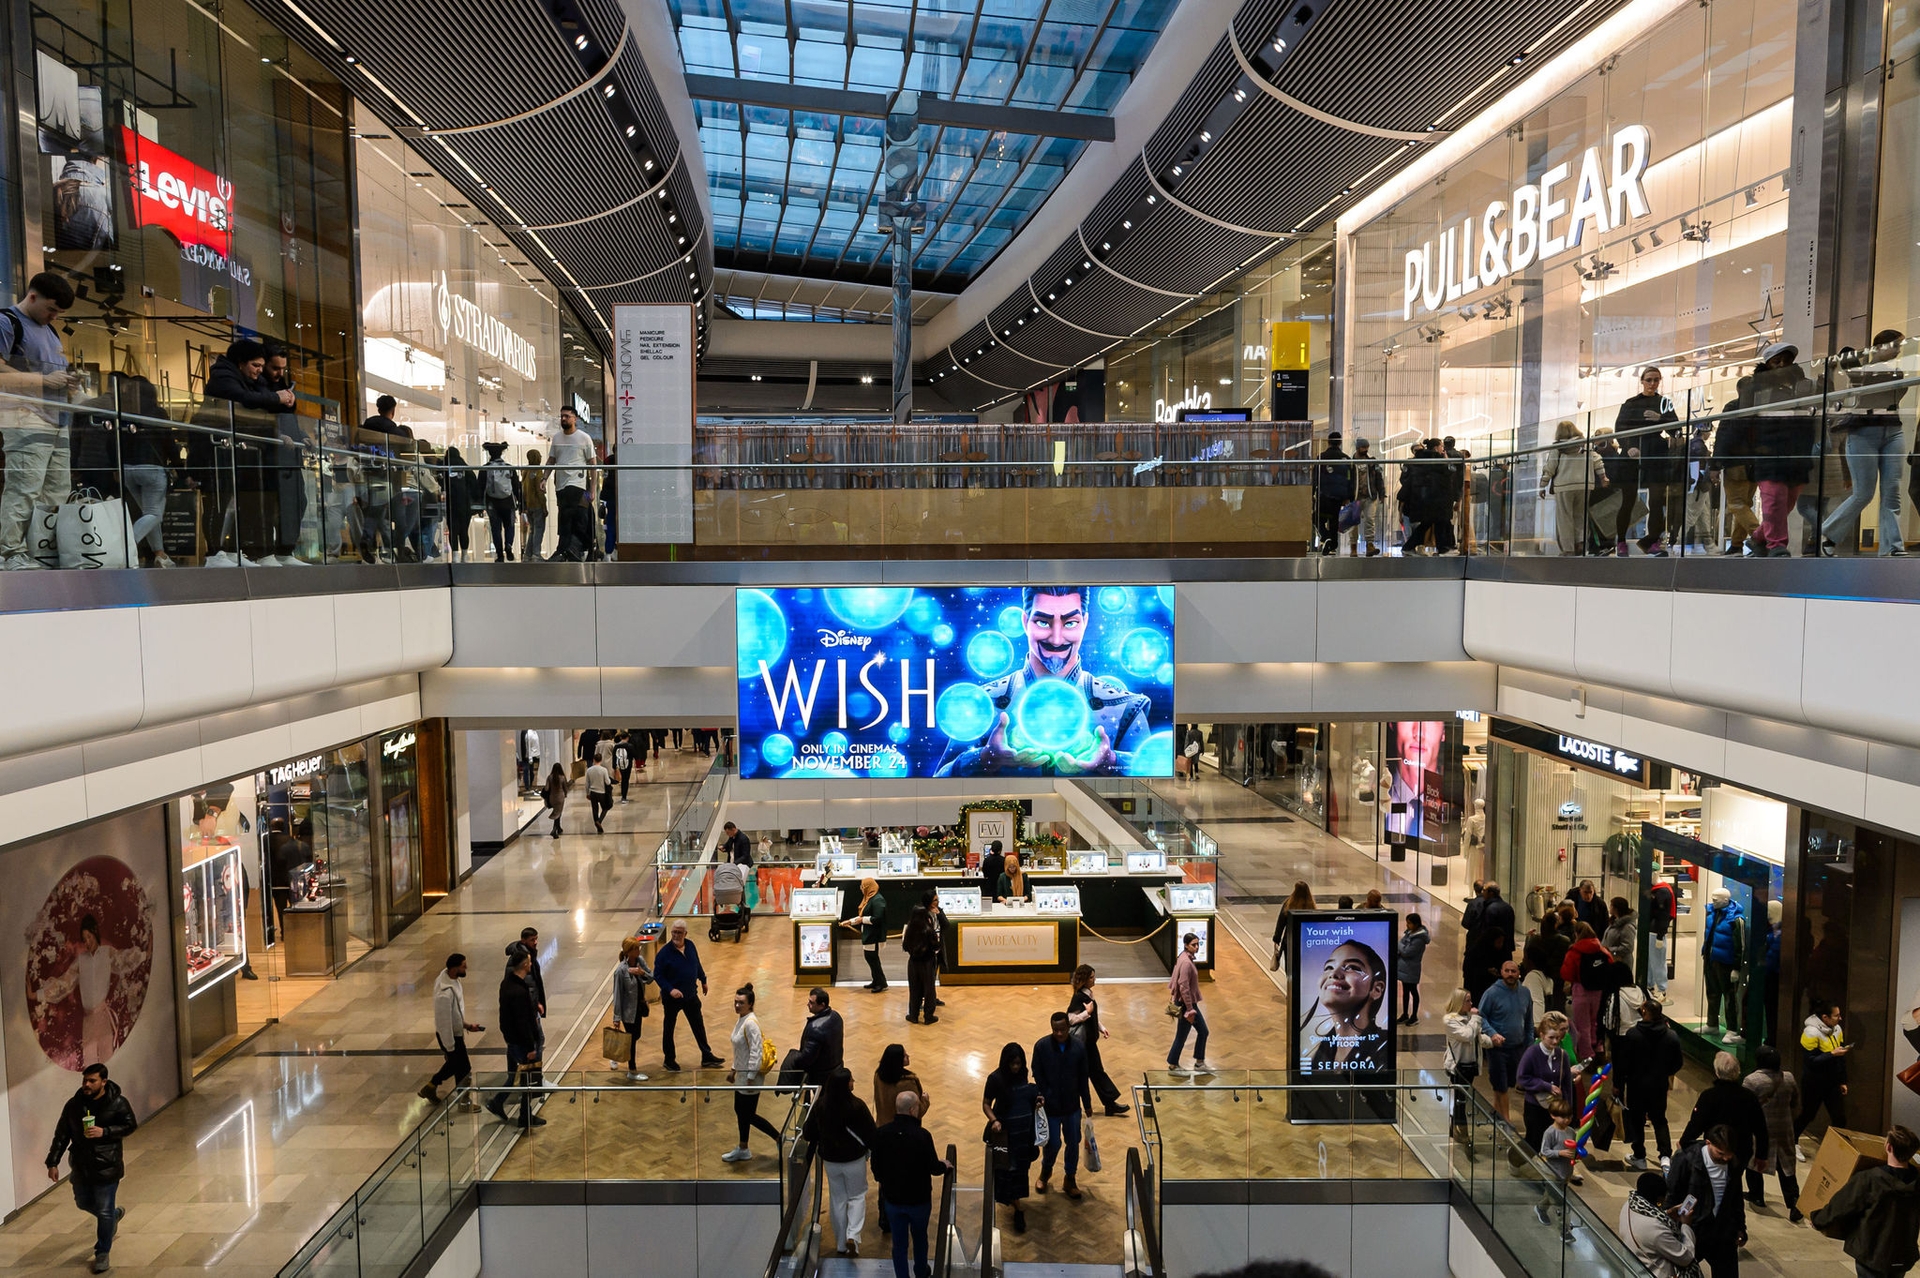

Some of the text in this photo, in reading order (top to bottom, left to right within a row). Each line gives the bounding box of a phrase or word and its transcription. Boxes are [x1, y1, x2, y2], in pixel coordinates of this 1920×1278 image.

[139, 160, 227, 231] Levi's
[1404, 124, 1651, 321] PULL&BEAR
[454, 293, 536, 381] STRADIVARIUS
[757, 657, 936, 731] WISH
[801, 743, 897, 754] ONLY IN CINEMAS
[1559, 735, 1611, 765] LACOSTE
[792, 755, 907, 769] NOVEMBER 24
[1426, 784, 1440, 798] Black
[981, 823, 1002, 835] FW
[1307, 926, 1354, 936] Your wish
[1306, 936, 1343, 948] granted.
[1309, 1035, 1331, 1044] Opens
[1332, 1033, 1366, 1042] November
[1318, 1061, 1375, 1070] SEPHORA
